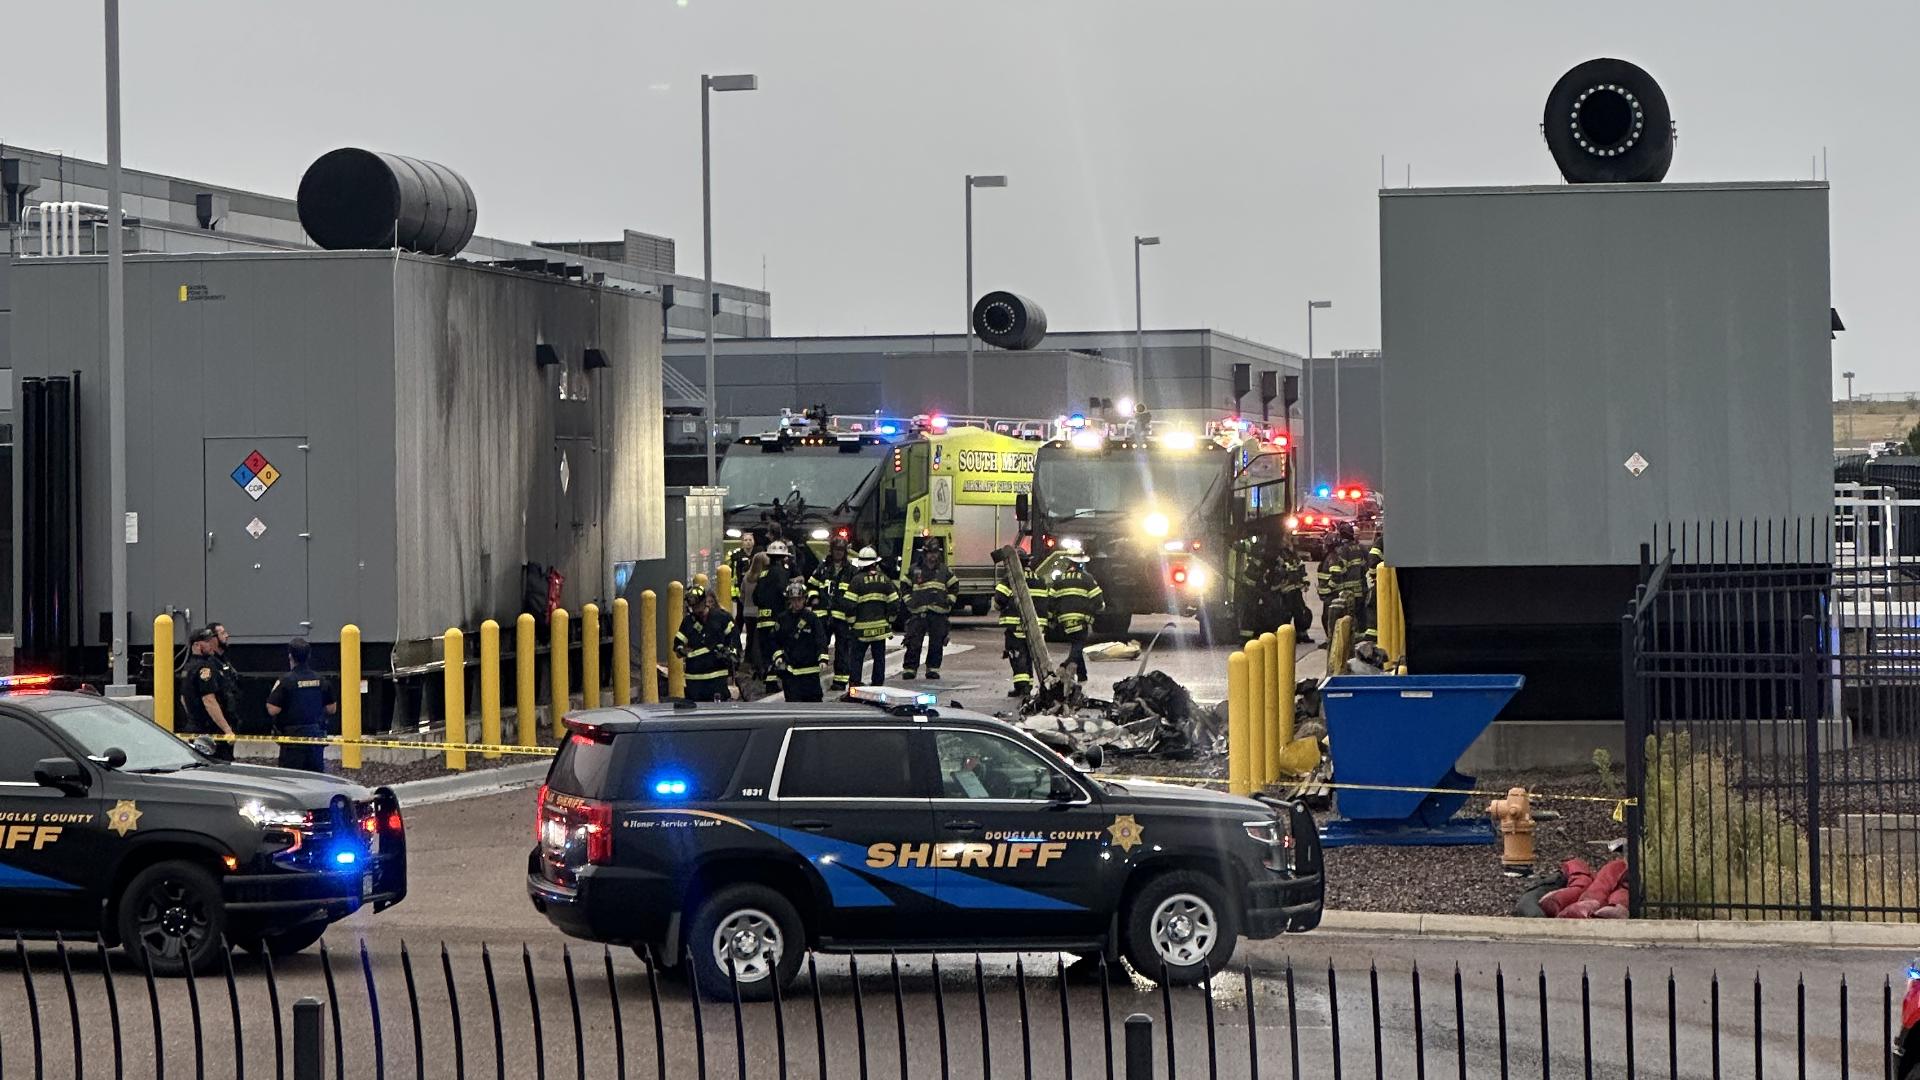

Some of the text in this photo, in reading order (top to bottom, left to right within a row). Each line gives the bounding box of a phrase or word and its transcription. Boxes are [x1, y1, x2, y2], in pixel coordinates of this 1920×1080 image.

[253, 459, 259, 467] 2
[959, 450, 999, 472] SOUTH
[266, 471, 272, 480] 0
[248, 484, 263, 492] COR
[742, 788, 763, 797] 1831
[43, 813, 94, 823] COUNTY
[630, 820, 654, 828] Honor
[661, 820, 687, 828] Service
[694, 820, 714, 828] Valor
[984, 831, 1102, 840] DOUGLAS COUNTY
[866, 843, 1067, 868] SHERIFF
